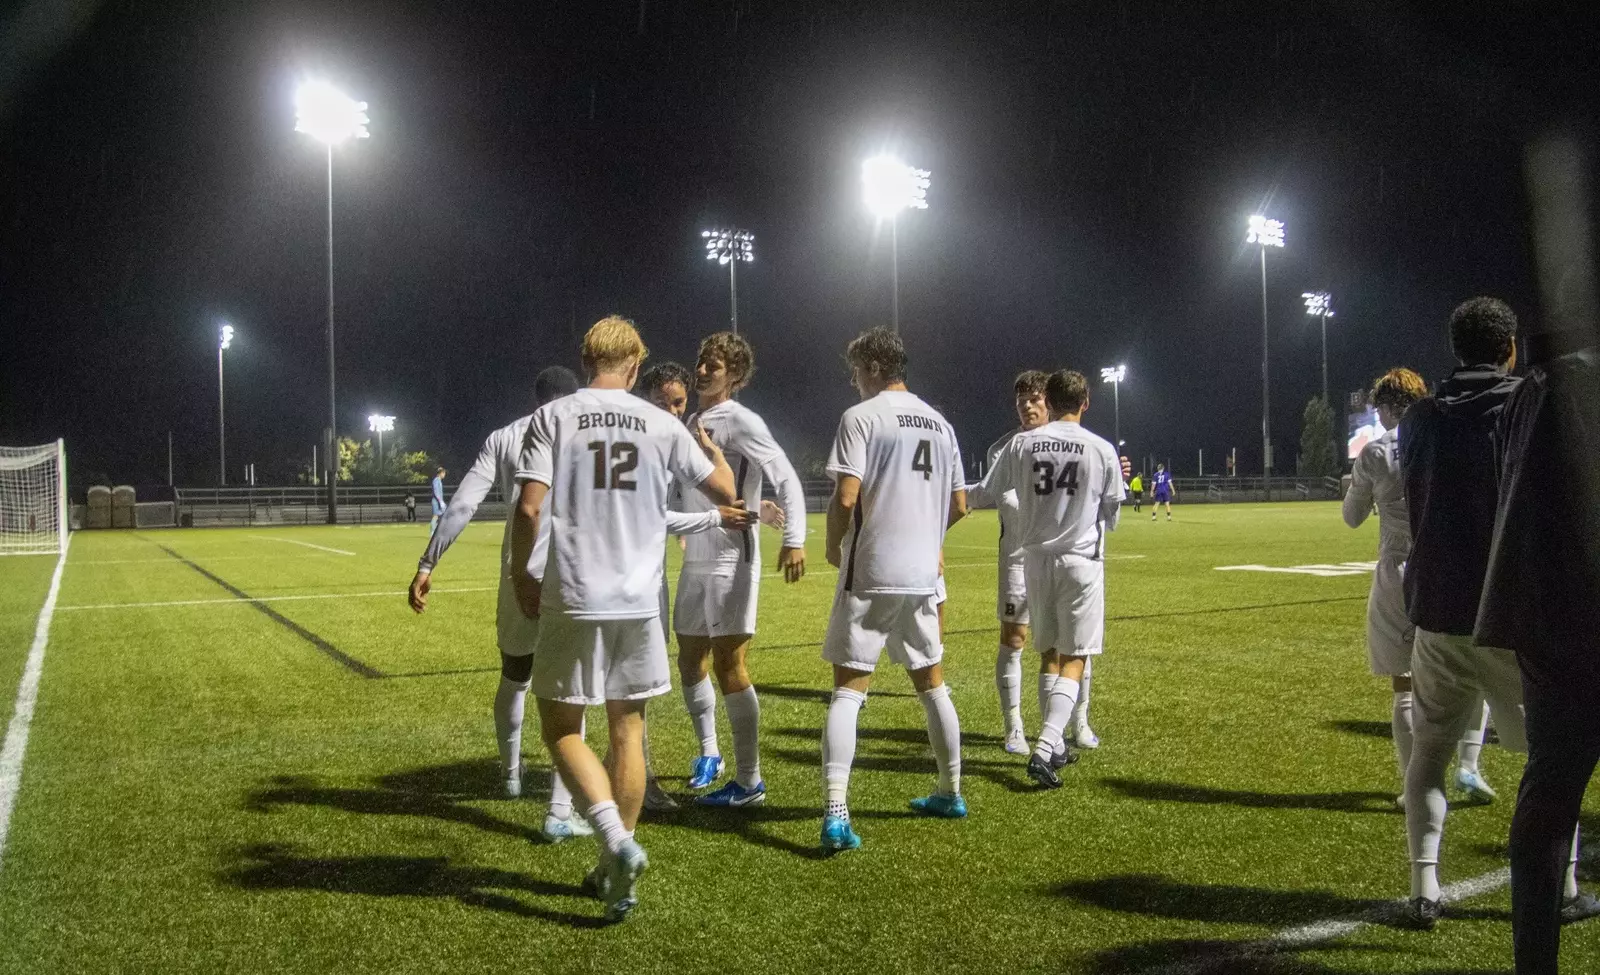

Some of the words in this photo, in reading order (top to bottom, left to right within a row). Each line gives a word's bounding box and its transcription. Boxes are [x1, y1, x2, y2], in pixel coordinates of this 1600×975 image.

[577, 412, 647, 433] BROWN
[896, 414, 943, 435] BROWN
[1032, 441, 1085, 455] BROWN
[587, 441, 639, 491] 12
[912, 439, 933, 481] 4
[1033, 460, 1079, 496] 34
[1005, 602, 1016, 617] B
